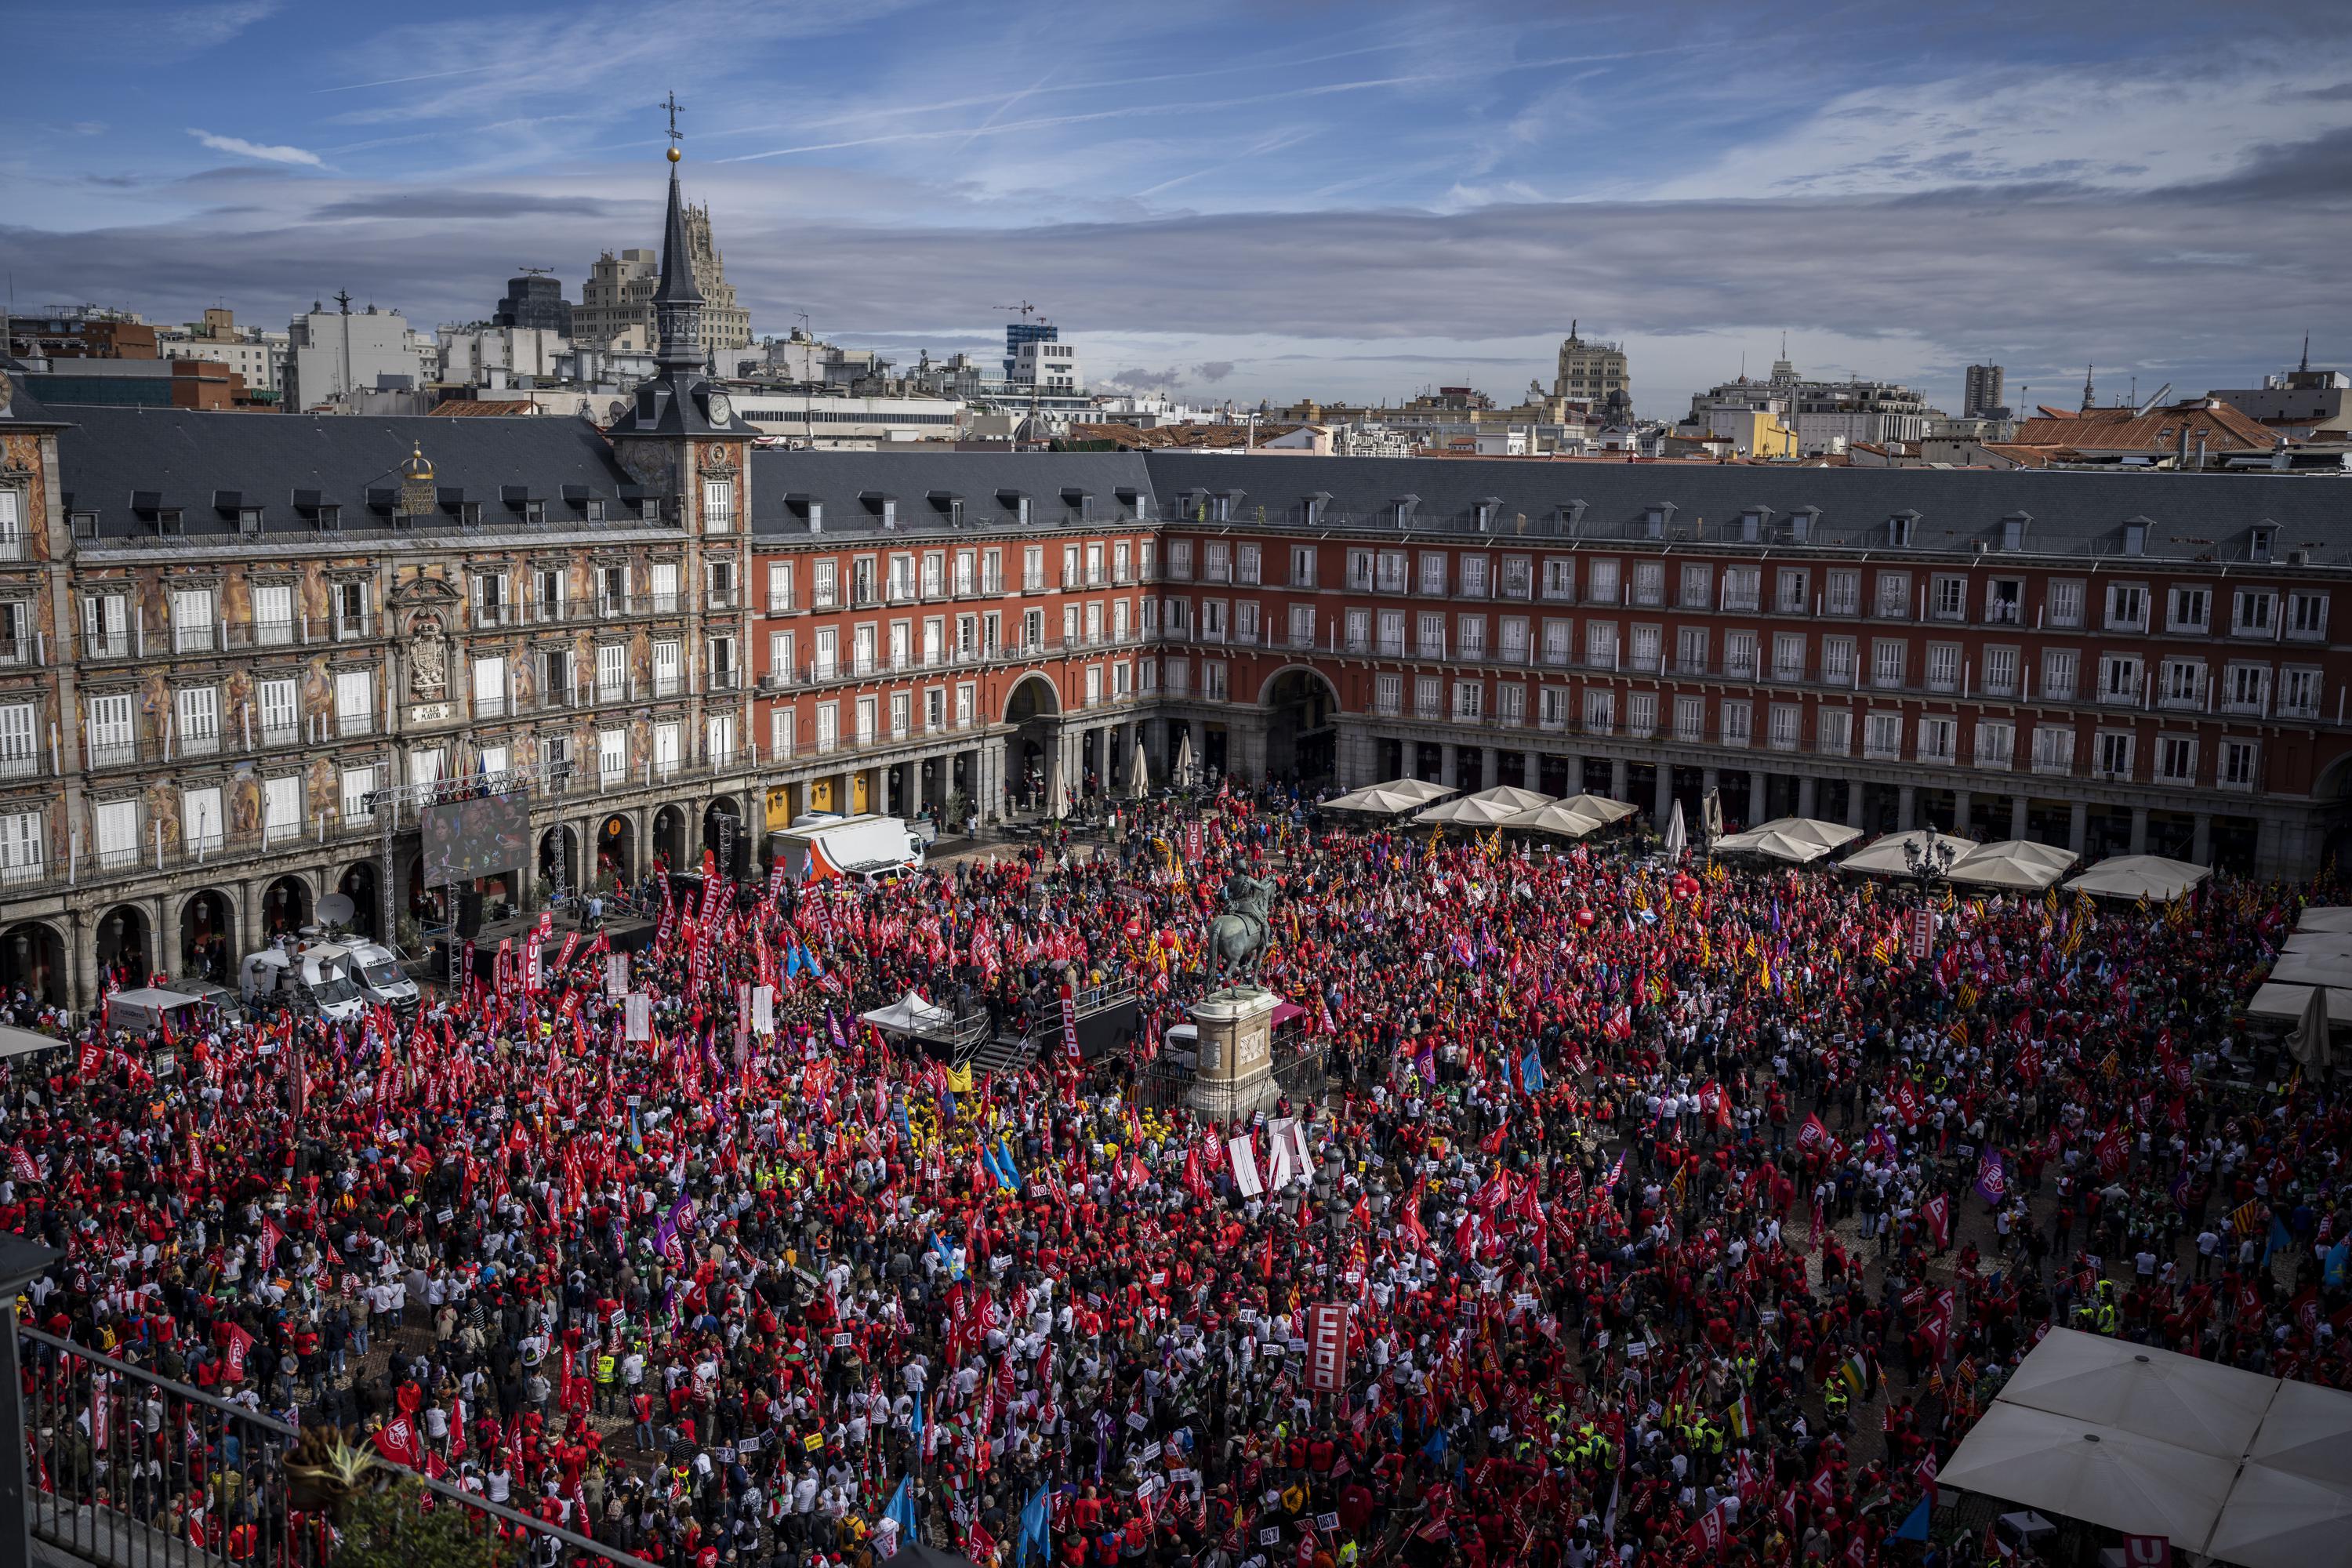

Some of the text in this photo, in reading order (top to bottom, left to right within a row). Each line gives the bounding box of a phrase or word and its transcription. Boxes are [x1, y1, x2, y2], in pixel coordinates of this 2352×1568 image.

[1189, 824, 1198, 853] UGT
[1913, 912, 1926, 957] CCOO
[561, 934, 577, 962] UGT
[367, 956, 392, 967] overon
[528, 945, 538, 991] UGT
[696, 936, 705, 990] CCOO
[464, 957, 474, 1002] UGT
[472, 1031, 484, 1040] NO
[1062, 999, 1080, 1057] CCOO
[756, 1057, 767, 1067] NO
[289, 1053, 298, 1103] UGT
[1900, 1086, 1916, 1109] UGT
[1164, 1151, 1175, 1161] NO
[1032, 1185, 1046, 1197] NO
[1462, 1301, 1477, 1315] BASTA!
[835, 1334, 851, 1346] BASTA!
[1461, 1330, 1477, 1339] NO
[1315, 1307, 1338, 1388] CCOO
[1295, 1519, 1315, 1531] NO
[1319, 1513, 1338, 1529] BASTA!
[1261, 1527, 1279, 1544] BASTA!
